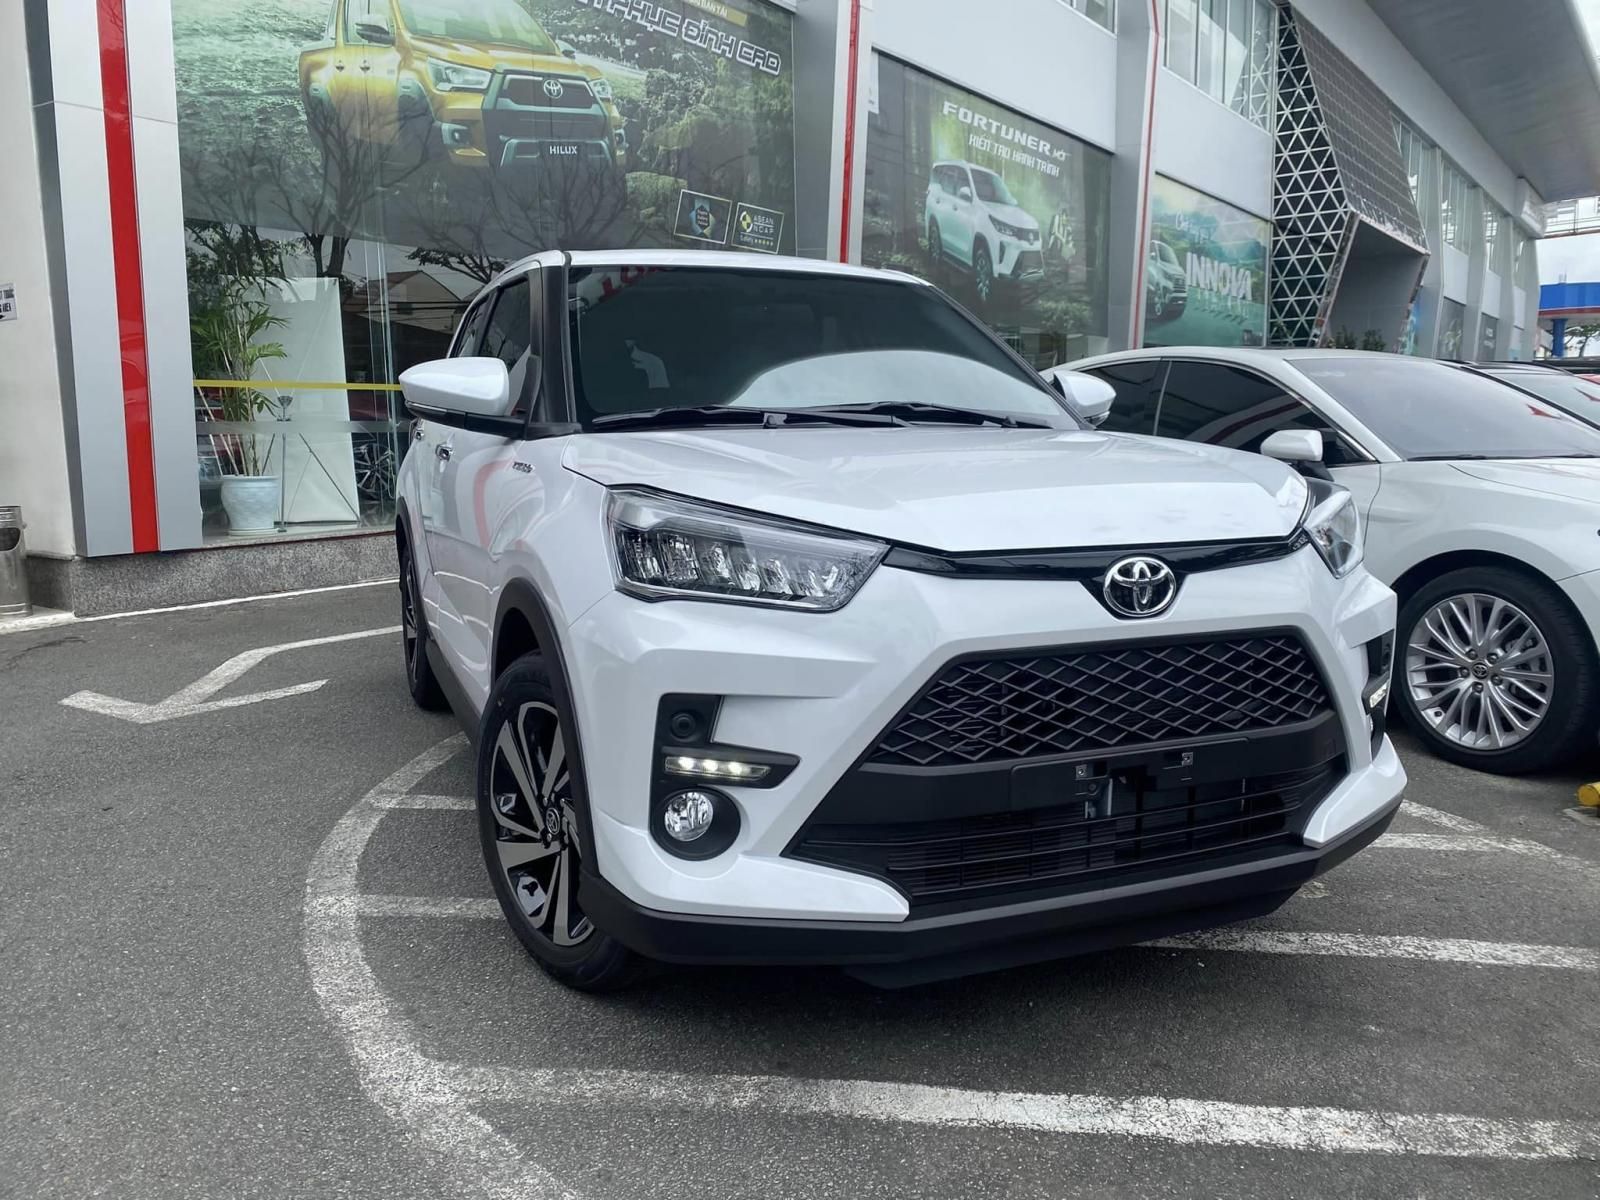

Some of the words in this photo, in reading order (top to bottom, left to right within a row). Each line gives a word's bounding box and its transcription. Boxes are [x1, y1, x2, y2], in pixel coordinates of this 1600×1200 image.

[942, 100, 1051, 156] FORTUNER
[549, 145, 577, 155] HILUX
[753, 215, 774, 225] ASEAN
[753, 226, 774, 234] NCAP
[1185, 251, 1252, 301] INNOVA
